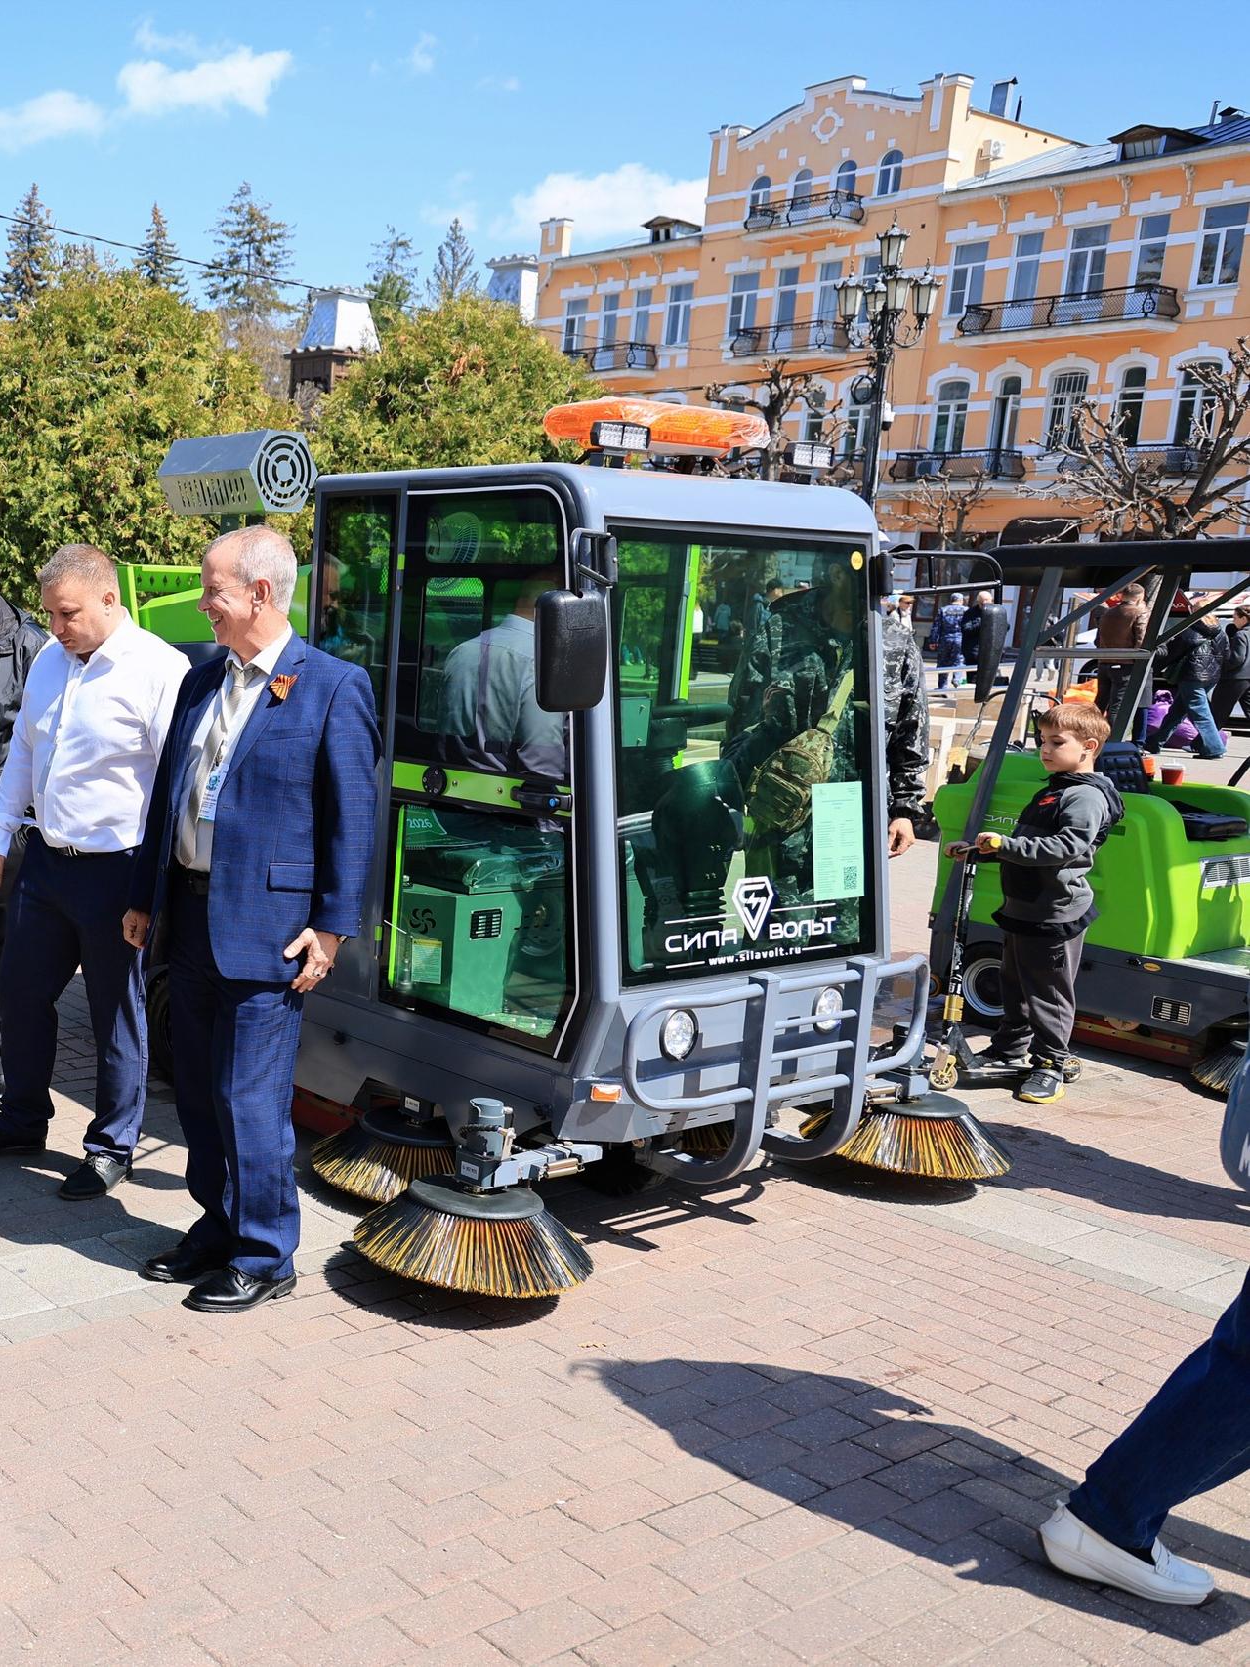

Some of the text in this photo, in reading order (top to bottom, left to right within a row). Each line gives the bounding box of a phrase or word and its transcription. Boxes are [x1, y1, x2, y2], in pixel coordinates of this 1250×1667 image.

[406, 818, 433, 829] 2026
[664, 917, 837, 952] СИЛА ВОЛЬТ
[708, 946, 802, 966] www.silavolt.ru
